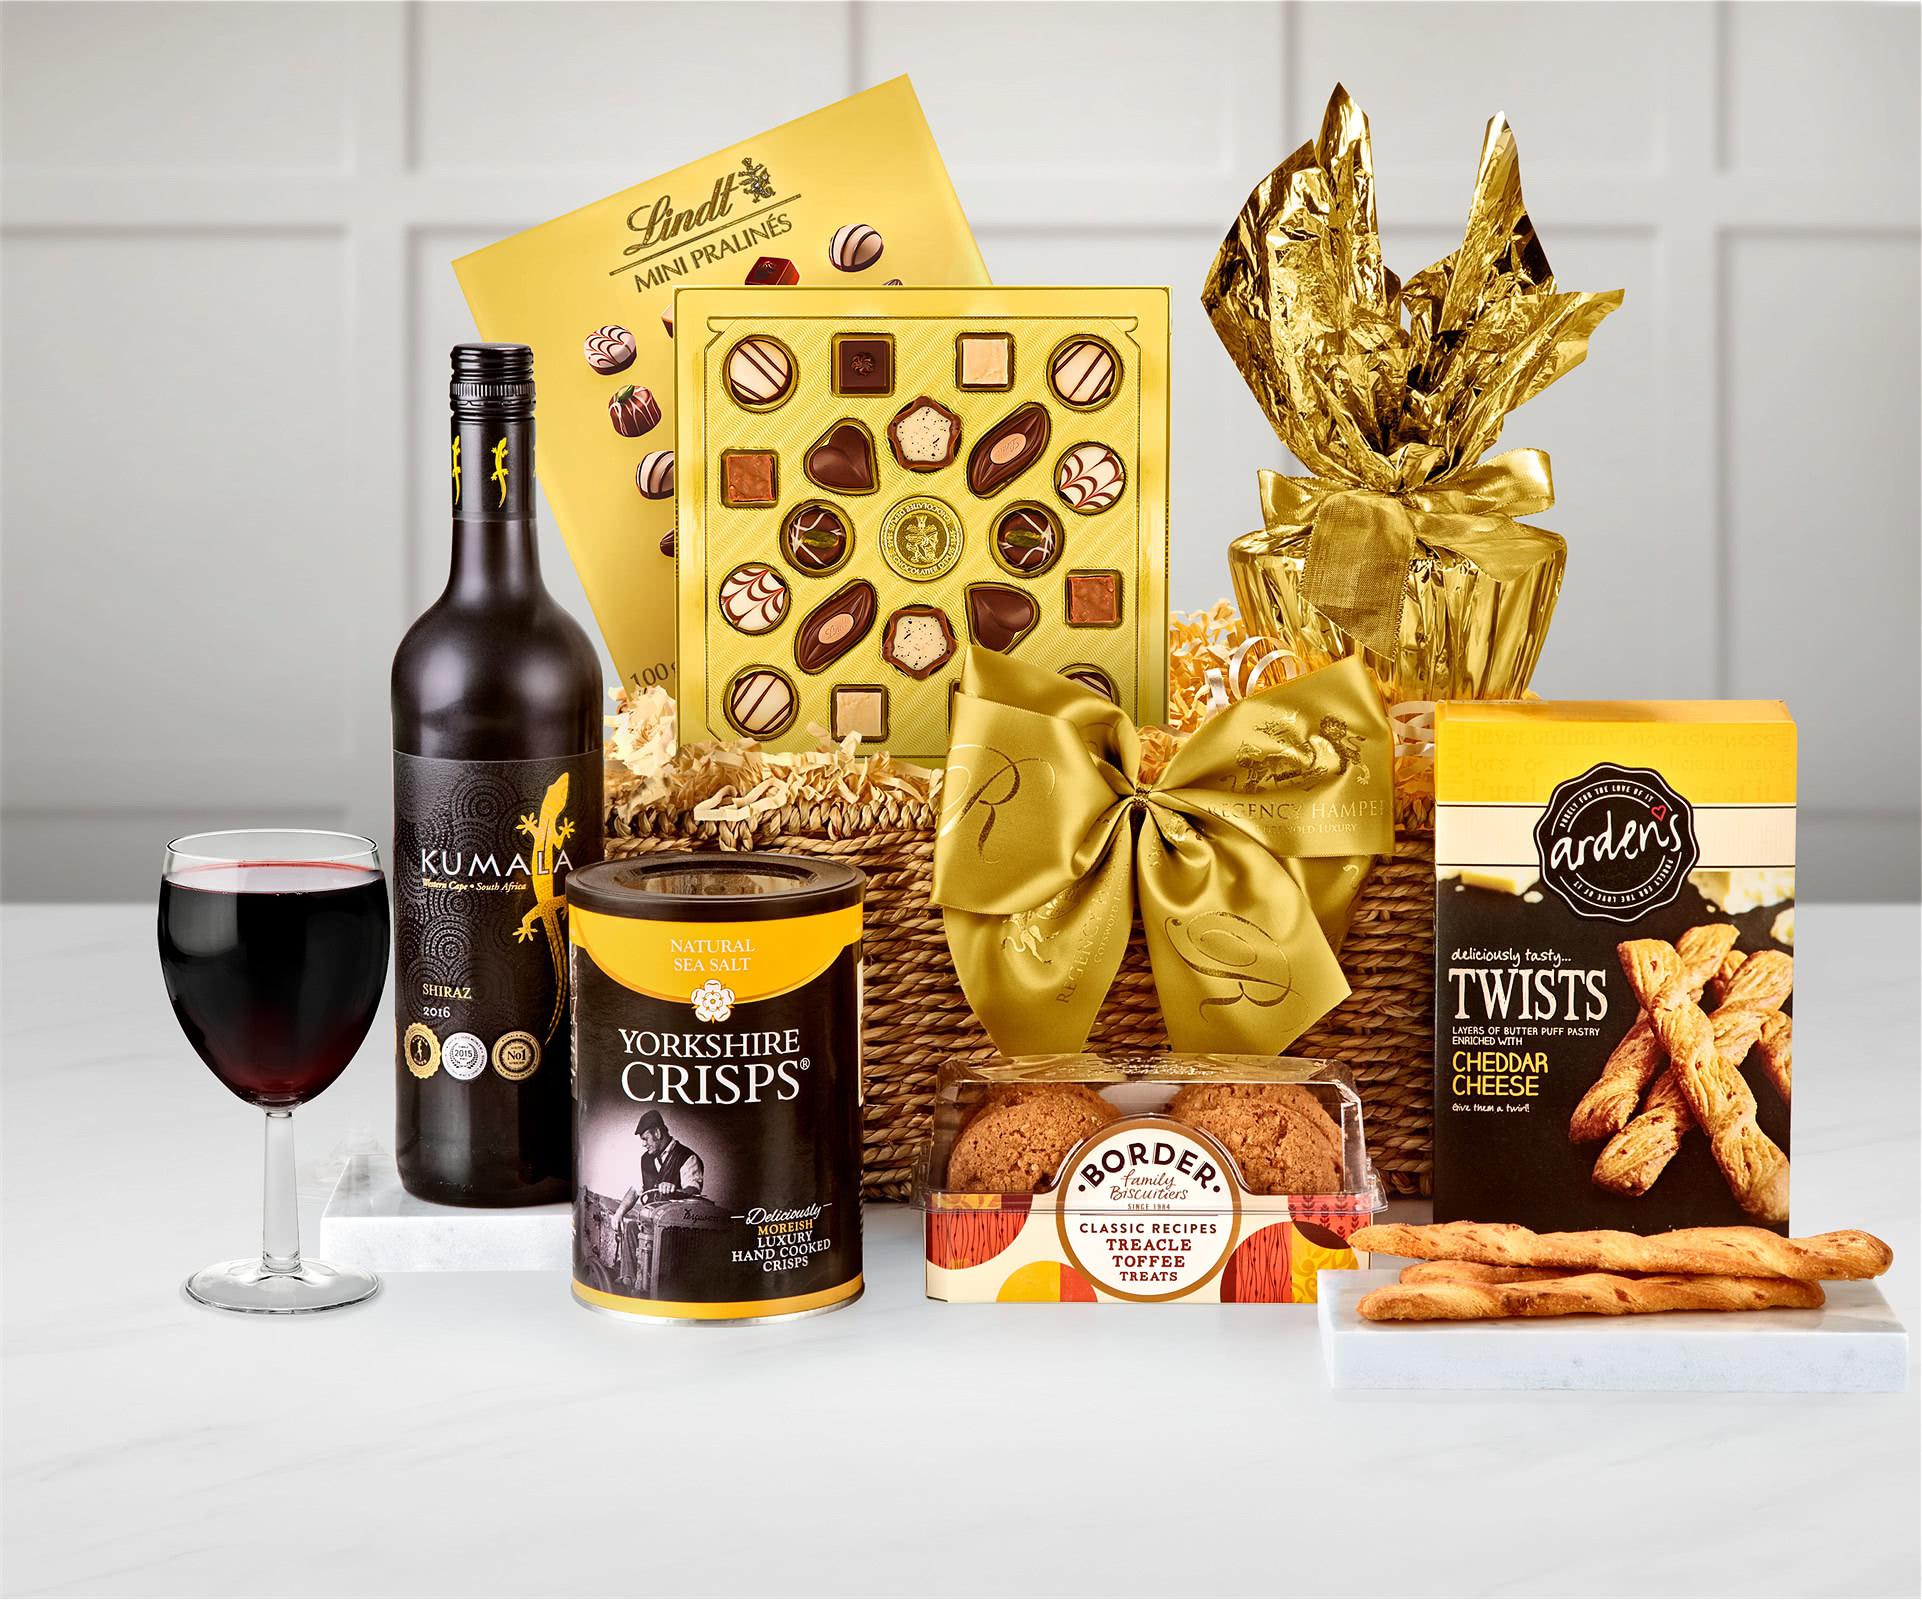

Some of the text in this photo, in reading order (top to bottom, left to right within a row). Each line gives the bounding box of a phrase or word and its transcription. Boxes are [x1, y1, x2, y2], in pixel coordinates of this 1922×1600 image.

[623, 172, 740, 256] Lindt
[634, 213, 792, 293] MINI PRALINÉS
[630, 663, 669, 687] 100
[1311, 799, 1393, 819] HAMPE
[1560, 784, 1654, 828] PURELY FOR THE LOVE OF IT
[1319, 823, 1357, 833] LUXURY
[421, 848, 574, 877] KUMALA
[422, 878, 527, 893] Western Cape South Africa
[1573, 859, 1674, 903] PURELY FOR THE LOVE OF IT
[1094, 905, 1120, 963] COTSWOLD
[670, 939, 755, 953] NATURAL
[674, 957, 752, 972] SEA SALT
[1451, 947, 1572, 968] deliciously tasty...
[422, 983, 472, 999] SHIRAZ
[1448, 968, 1608, 1021] TWISTS
[423, 1006, 451, 1018] 2016
[1452, 1026, 1600, 1036] LAYERS OF BUTTER PUFF PASTRY
[618, 1028, 800, 1058] YORKSHIRE
[1452, 1036, 1523, 1046] ENRICHED WITH
[1452, 1050, 1549, 1073] CHEDDAR
[1452, 1074, 1539, 1096] CHEESE
[1452, 1102, 1471, 1112] Give
[1473, 1103, 1494, 1112] them
[1079, 1142, 1217, 1190] BORDER
[1120, 1168, 1177, 1188] family
[1109, 1185, 1189, 1201] Biscuitiers
[746, 1202, 822, 1225] Deliciously
[757, 1219, 814, 1236] MOREISH
[1079, 1223, 1218, 1234] CLASSIC RECIPES
[757, 1230, 813, 1248] LUXURY
[1105, 1238, 1192, 1251] TREACLE
[731, 1238, 831, 1263] HAND COOKED
[762, 1255, 809, 1272] CRISPS
[1112, 1255, 1185, 1268] TOFFEE
[1119, 1271, 1178, 1282] TREATS
